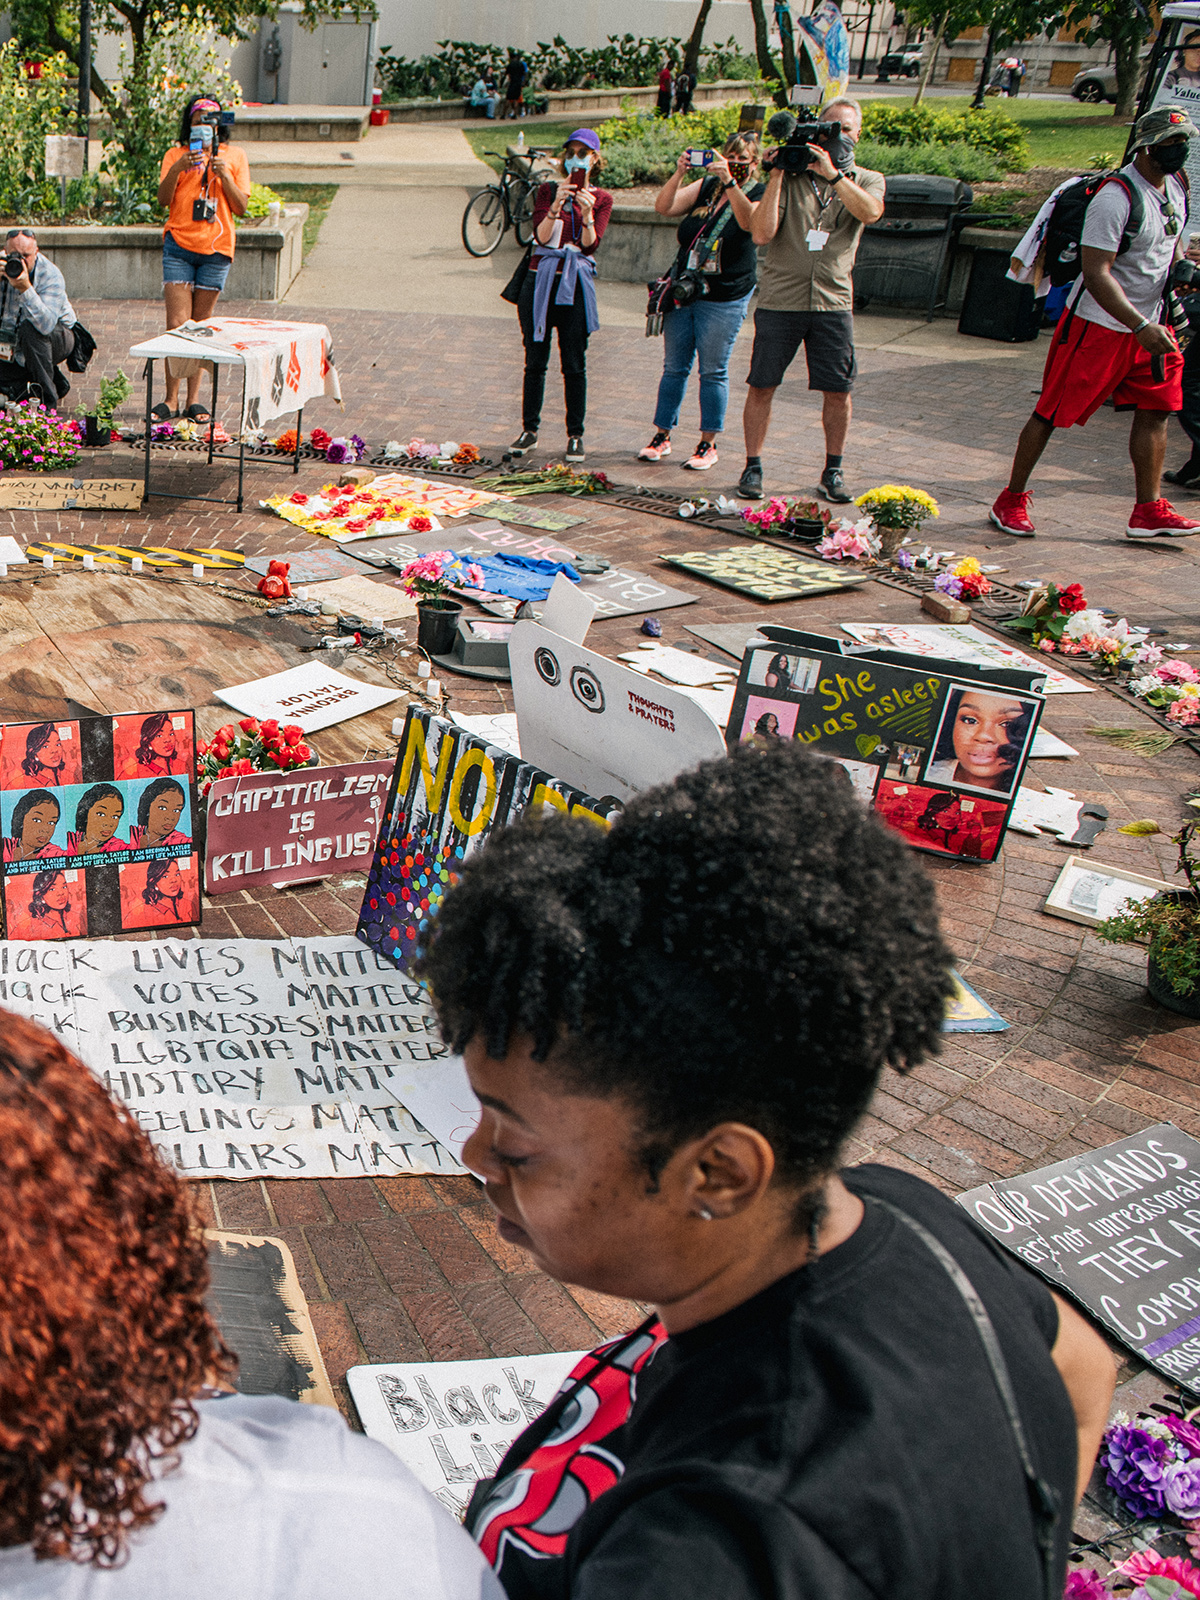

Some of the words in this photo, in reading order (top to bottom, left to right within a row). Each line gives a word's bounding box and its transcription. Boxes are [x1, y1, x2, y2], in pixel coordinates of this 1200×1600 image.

[276, 684, 343, 707] TAYLOR
[285, 689, 359, 718] BREONNA
[627, 690, 674, 720] THOUGHTS
[819, 671, 876, 711] She
[628, 703, 634, 712] &
[635, 706, 675, 732] PRAYERS
[797, 712, 858, 744] was
[865, 677, 941, 719] asleep
[397, 718, 497, 836] NO
[215, 774, 394, 817] CAPITALISM
[289, 810, 315, 834] IS
[18, 858, 50, 867] BREONNA
[50, 856, 66, 864] TAYLOR
[82, 853, 108, 861] BREONNA
[109, 850, 130, 858] TAYLOR
[105, 856, 130, 864] MATTERS
[145, 847, 171, 855] BREONNA
[171, 844, 191, 852] TAYLOR
[167, 850, 191, 858] MATTERS
[132, 945, 244, 977] LIVES
[271, 945, 402, 978] MATTE
[133, 980, 259, 1006] VOTES
[287, 982, 433, 1010] MATTER
[108, 1010, 320, 1037] BUSINESSES
[311, 1037, 451, 1063] MATTER
[103, 1067, 265, 1100] HISTORY
[130, 1107, 296, 1133] EELINGS
[154, 1142, 306, 1170] LLARS
[329, 1141, 463, 1172] MATT
[975, 1190, 1051, 1234] OUR
[1031, 1140, 1188, 1218] DEMANDS
[1017, 1237, 1060, 1263] are
[1050, 1225, 1093, 1254] not
[1077, 1228, 1185, 1284] THEY
[376, 1367, 549, 1433] Black
